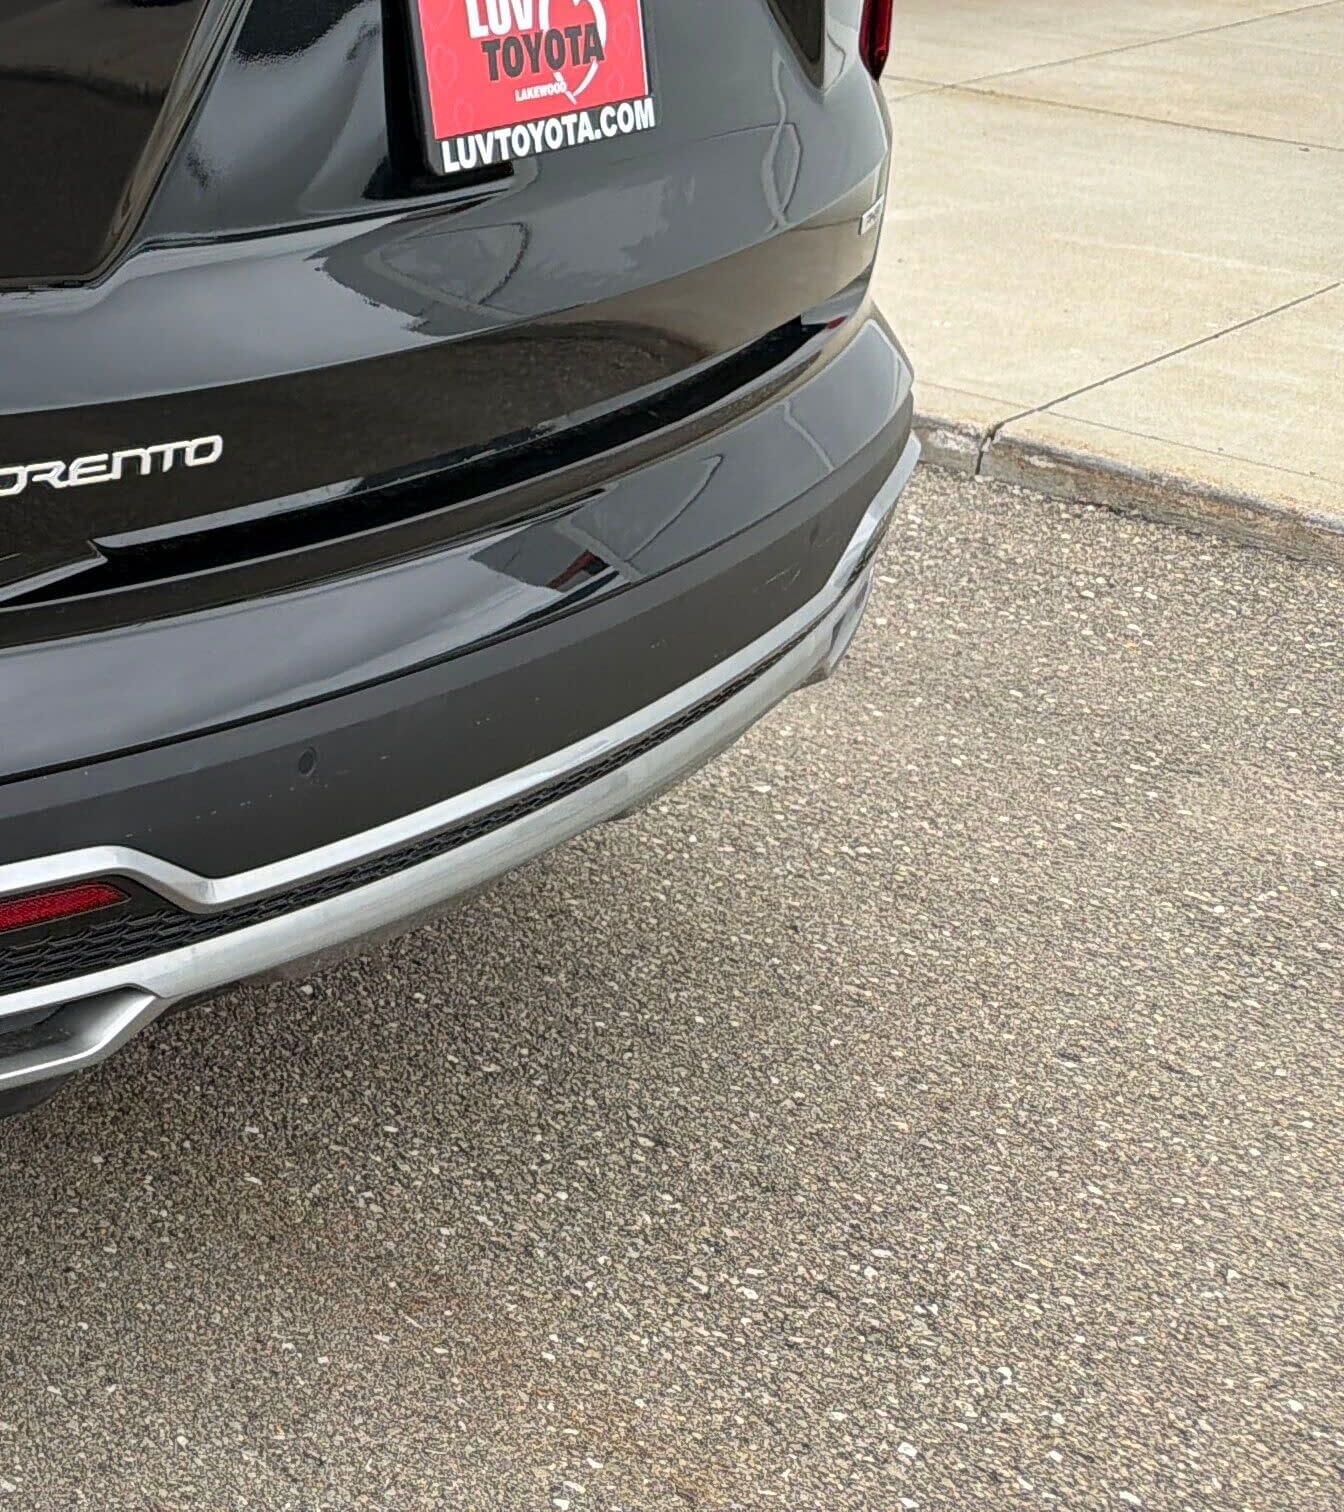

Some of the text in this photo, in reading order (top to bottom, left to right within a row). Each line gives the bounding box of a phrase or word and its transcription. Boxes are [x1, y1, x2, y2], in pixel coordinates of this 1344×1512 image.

[481, 22, 605, 82] TOYOTA
[514, 80, 567, 102] LAKEWOOD
[441, 97, 656, 174] LUVTOYOTA.COM
